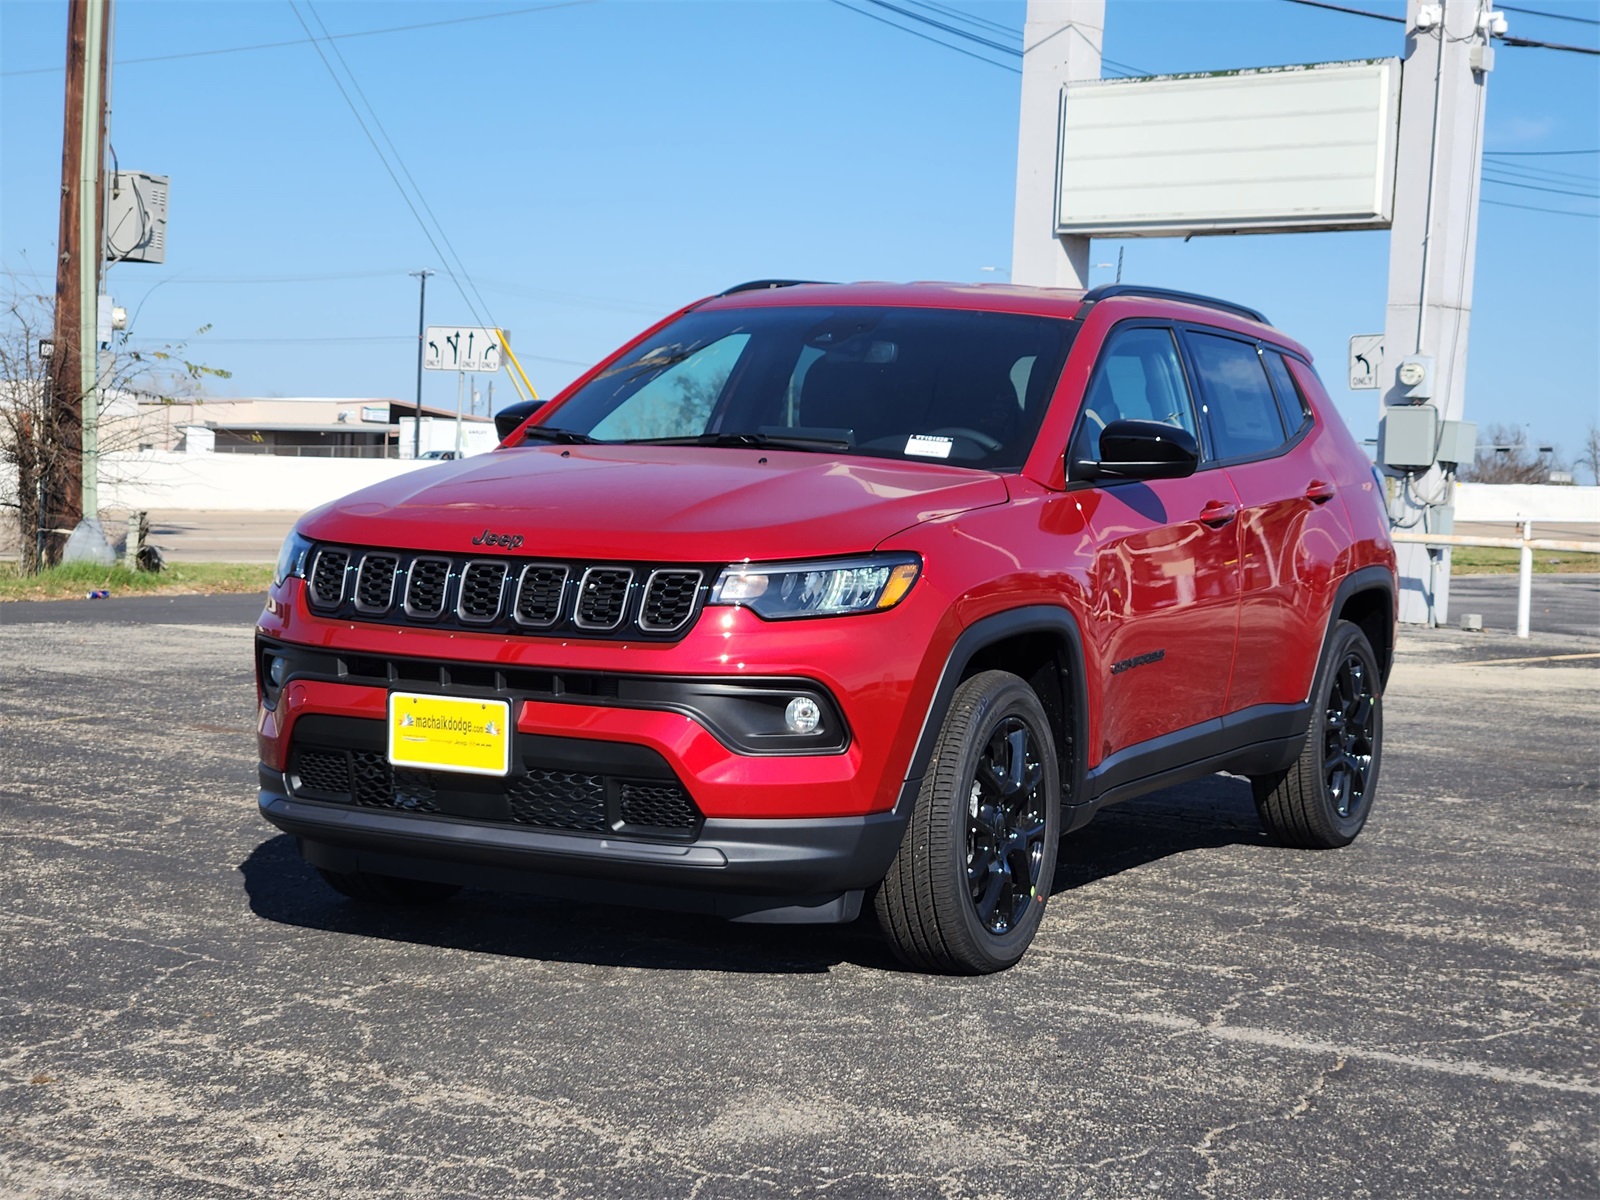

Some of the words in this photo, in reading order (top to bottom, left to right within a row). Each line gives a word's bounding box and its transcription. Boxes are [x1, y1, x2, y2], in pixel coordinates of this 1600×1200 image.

[1352, 377, 1373, 386] ONLY
[472, 529, 525, 551] Jeep
[415, 714, 484, 735] machaikdodge.com
